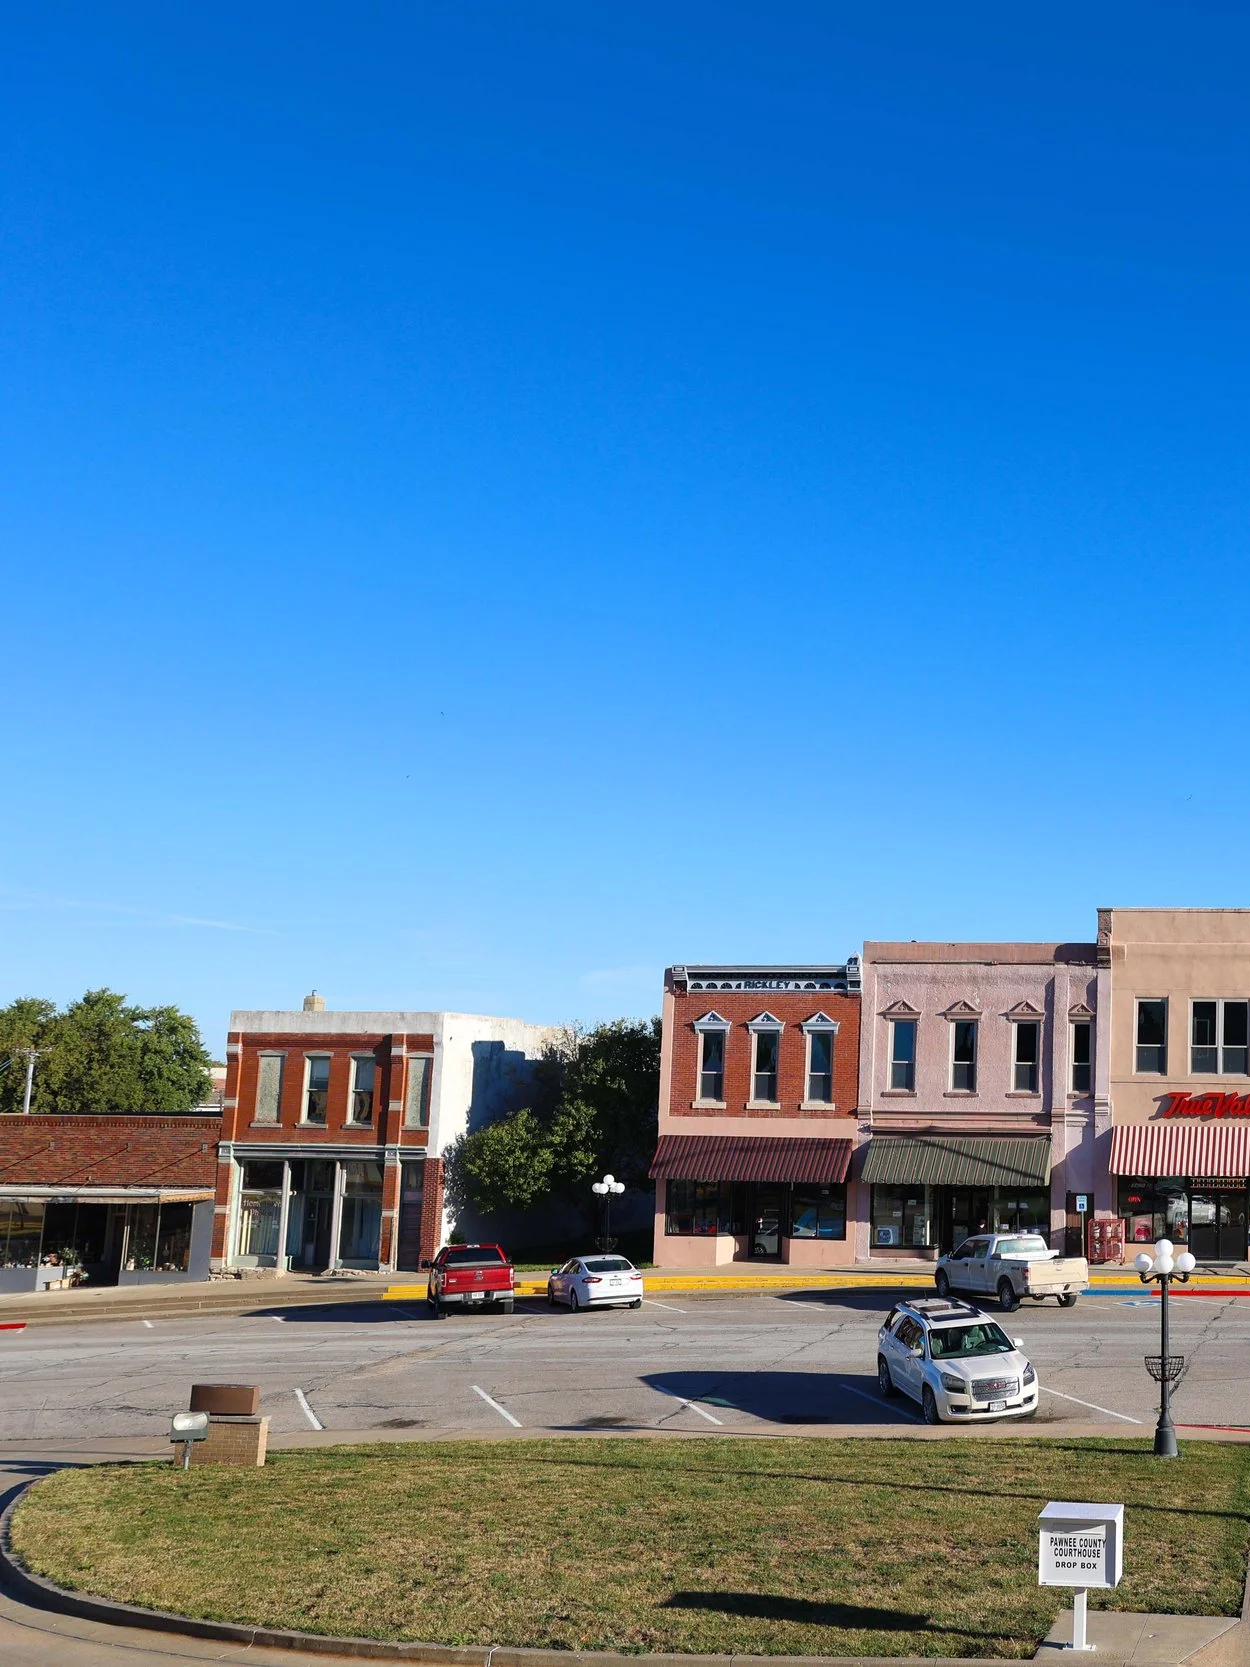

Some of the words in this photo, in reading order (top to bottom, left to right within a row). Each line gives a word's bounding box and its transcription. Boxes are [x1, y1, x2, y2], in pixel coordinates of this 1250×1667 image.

[743, 980, 791, 989] RICKLEY
[1162, 1091, 1214, 1118] True
[1050, 1537, 1077, 1547] PAWNEE
[1079, 1538, 1107, 1548] COUNTY
[1054, 1548, 1101, 1558] COURTHOUSE
